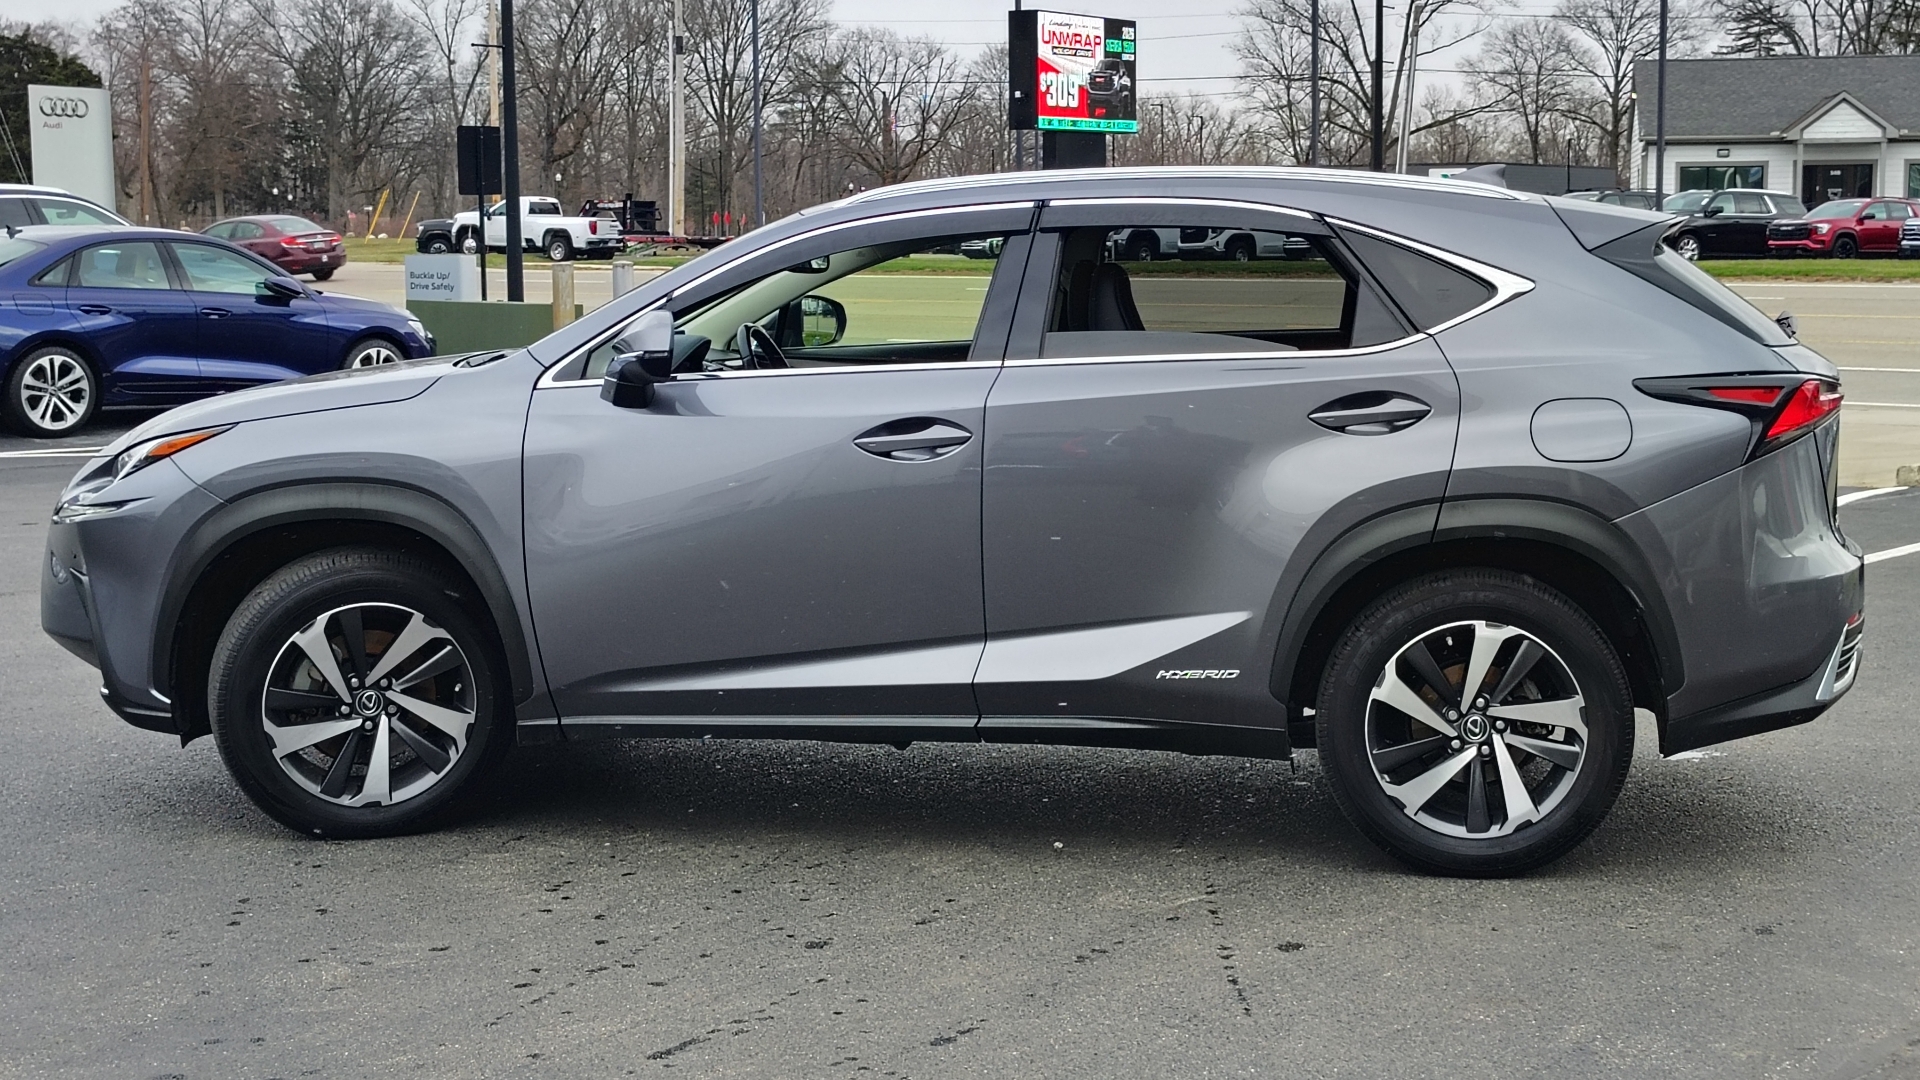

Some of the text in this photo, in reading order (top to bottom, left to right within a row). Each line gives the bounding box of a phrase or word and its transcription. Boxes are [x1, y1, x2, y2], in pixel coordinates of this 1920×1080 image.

[1041, 23, 1101, 55] UNWRAP
[1040, 71, 1078, 107] $309
[43, 121, 63, 129] Audi
[409, 271, 451, 281] Buckle Up/
[410, 282, 455, 292] Drive Safely
[1156, 669, 1240, 680] HYBRID
